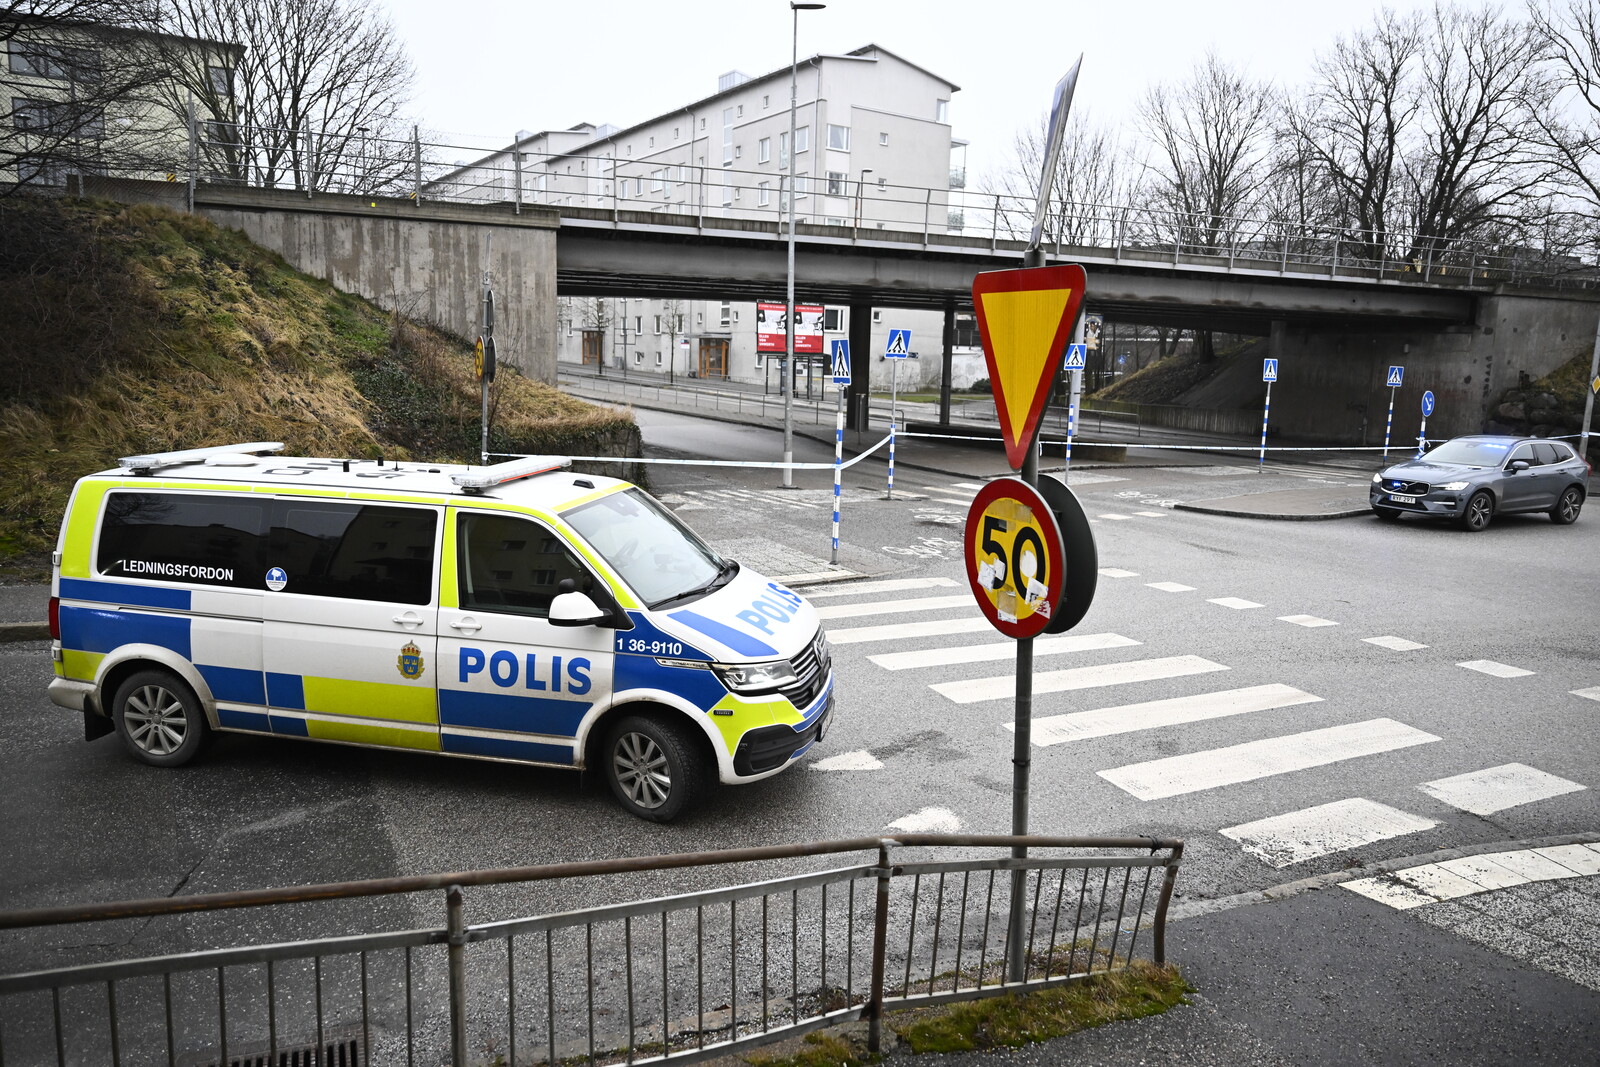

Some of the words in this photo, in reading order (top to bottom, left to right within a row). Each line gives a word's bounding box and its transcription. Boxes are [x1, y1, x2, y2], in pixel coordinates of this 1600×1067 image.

[123, 560, 234, 581] LEDNINGSFORDON
[982, 515, 1046, 602] 50
[735, 582, 802, 636] POLIS
[459, 647, 592, 695] POLIS
[617, 639, 623, 650] 1
[628, 639, 682, 655] 36-9110
